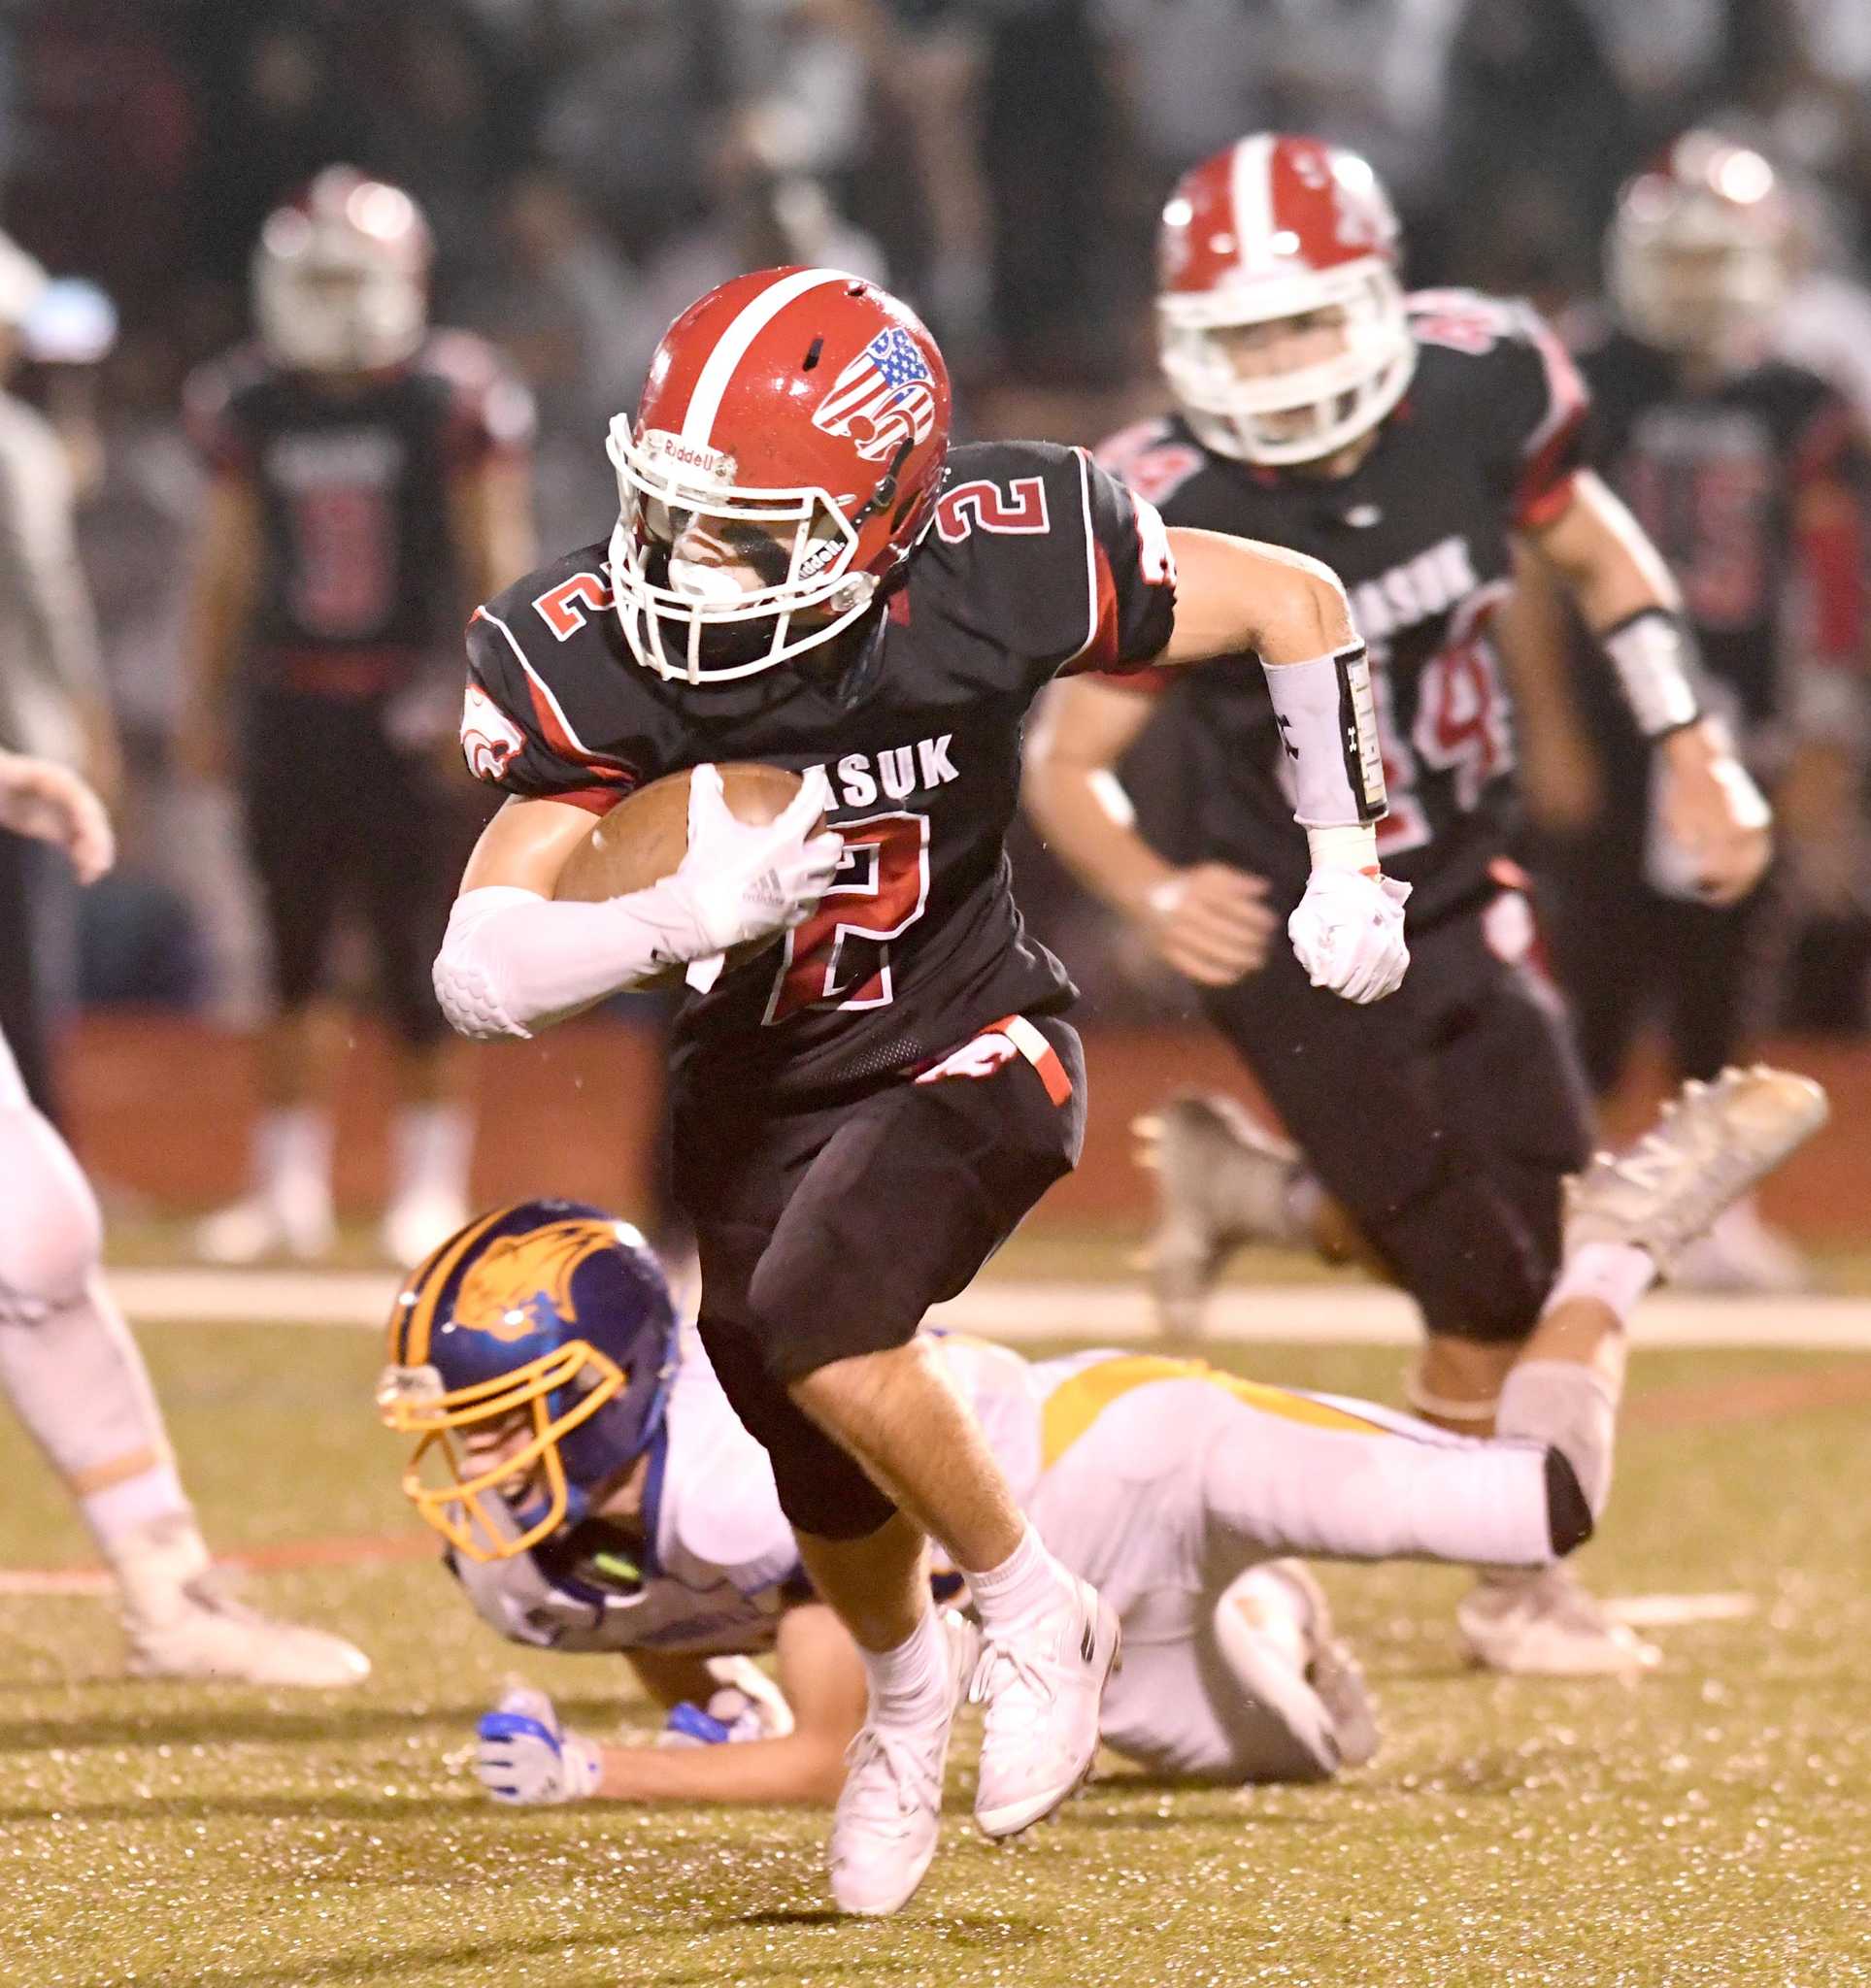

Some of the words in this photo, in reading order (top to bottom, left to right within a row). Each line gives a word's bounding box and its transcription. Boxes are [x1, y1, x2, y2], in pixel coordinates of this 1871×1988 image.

[935, 477, 1050, 544] 2
[798, 540, 842, 580] iddell
[531, 561, 617, 642] 2
[761, 811, 931, 1025] 2
